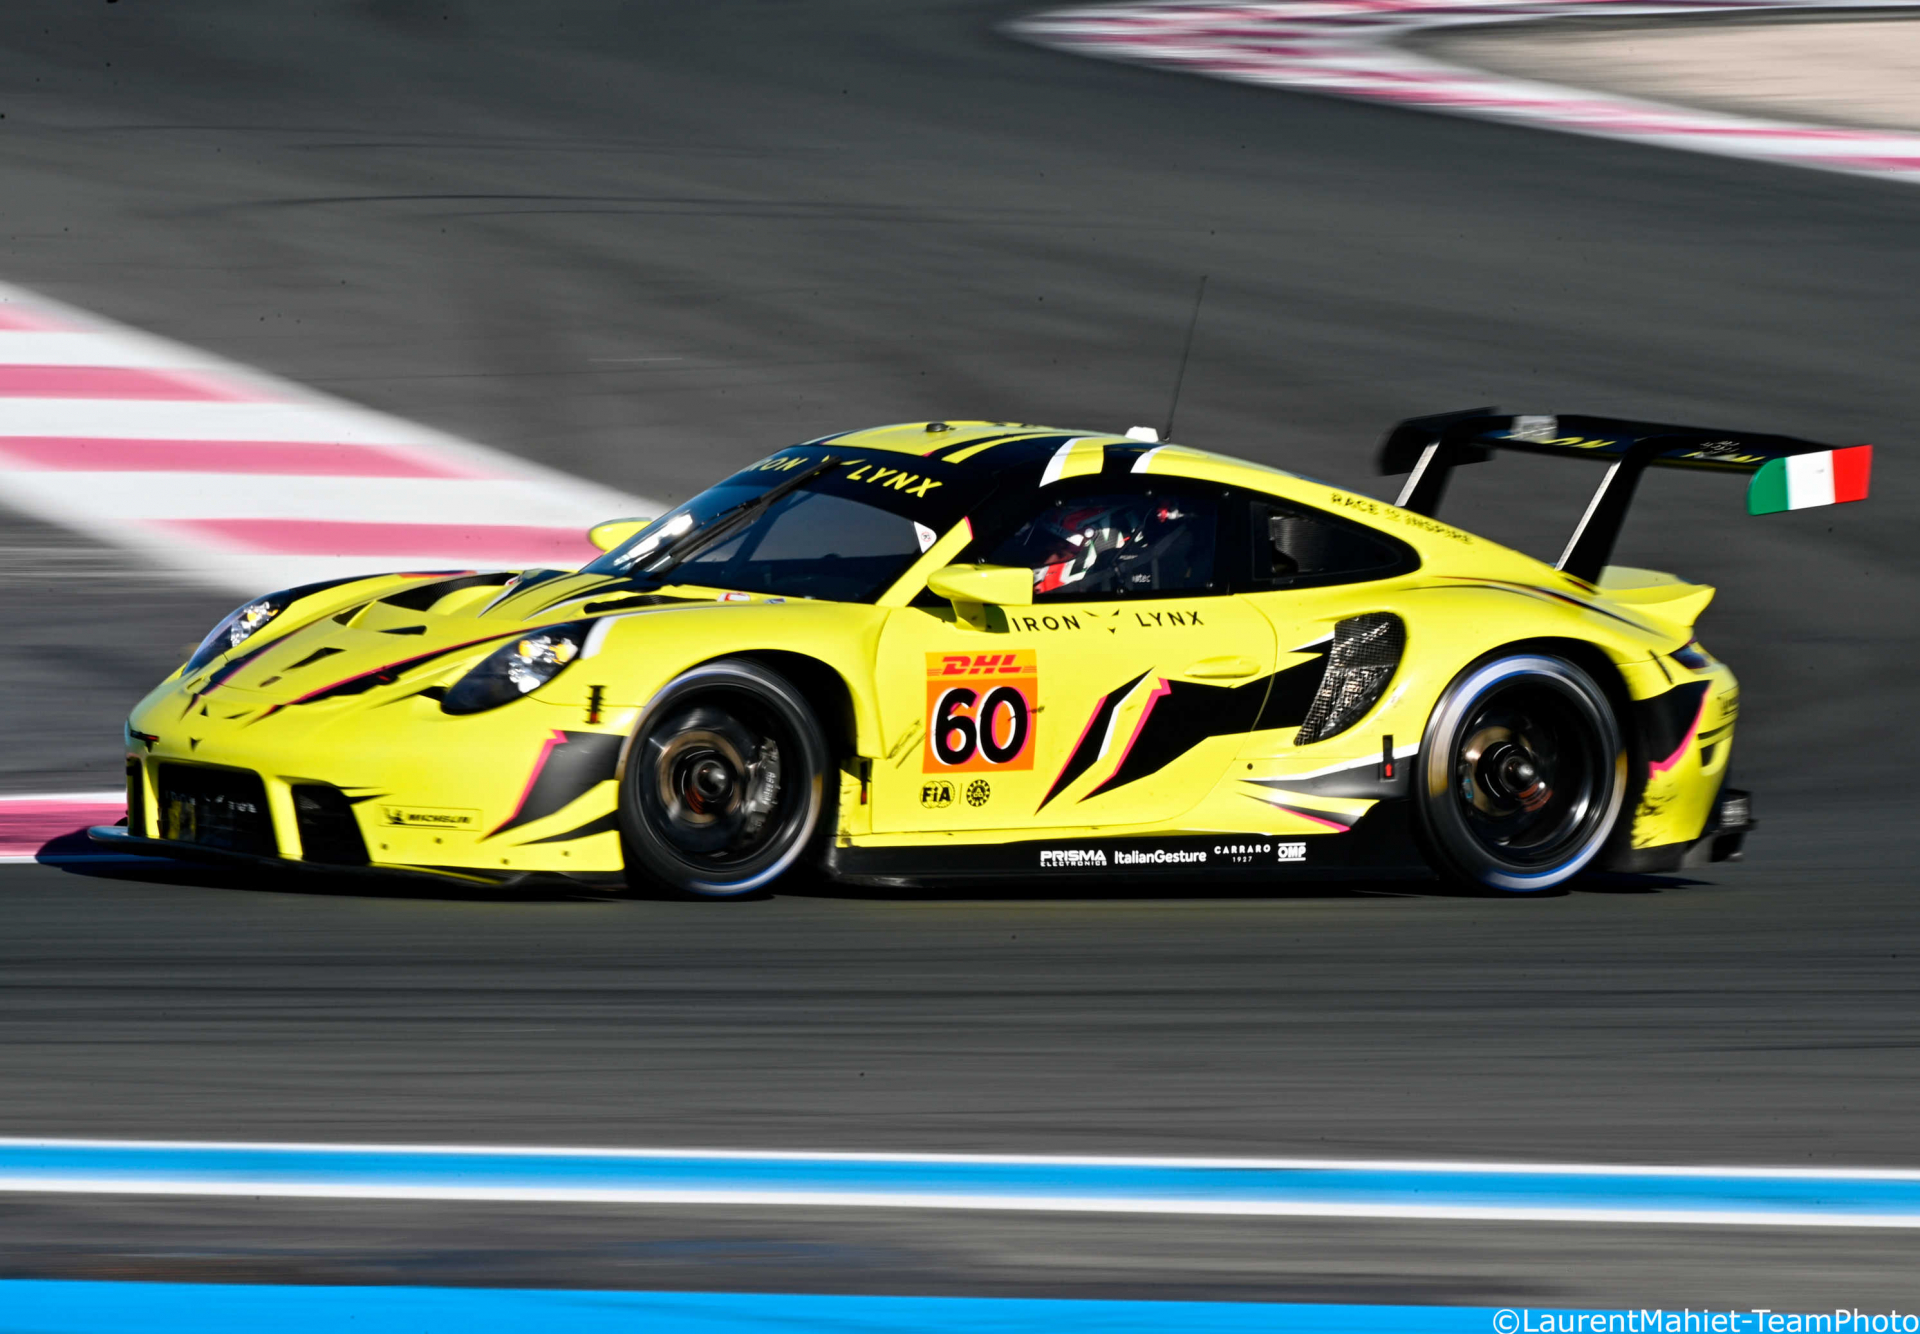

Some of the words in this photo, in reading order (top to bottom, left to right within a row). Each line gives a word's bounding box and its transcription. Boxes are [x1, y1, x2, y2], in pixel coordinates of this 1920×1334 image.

[846, 464, 943, 498] LYNX
[1331, 492, 1379, 516] RACE
[1012, 614, 1082, 632] IRON
[1135, 610, 1205, 627] LYNX
[942, 654, 1022, 675] DHL
[930, 685, 1032, 766] 60
[407, 813, 471, 824] MICHELIN
[1040, 849, 1107, 861] PRISMA
[1213, 843, 1271, 854] CARRARO
[1278, 845, 1306, 859] OMP
[1114, 849, 1207, 865] ItalianGesture
[1232, 855, 1253, 863] 1927
